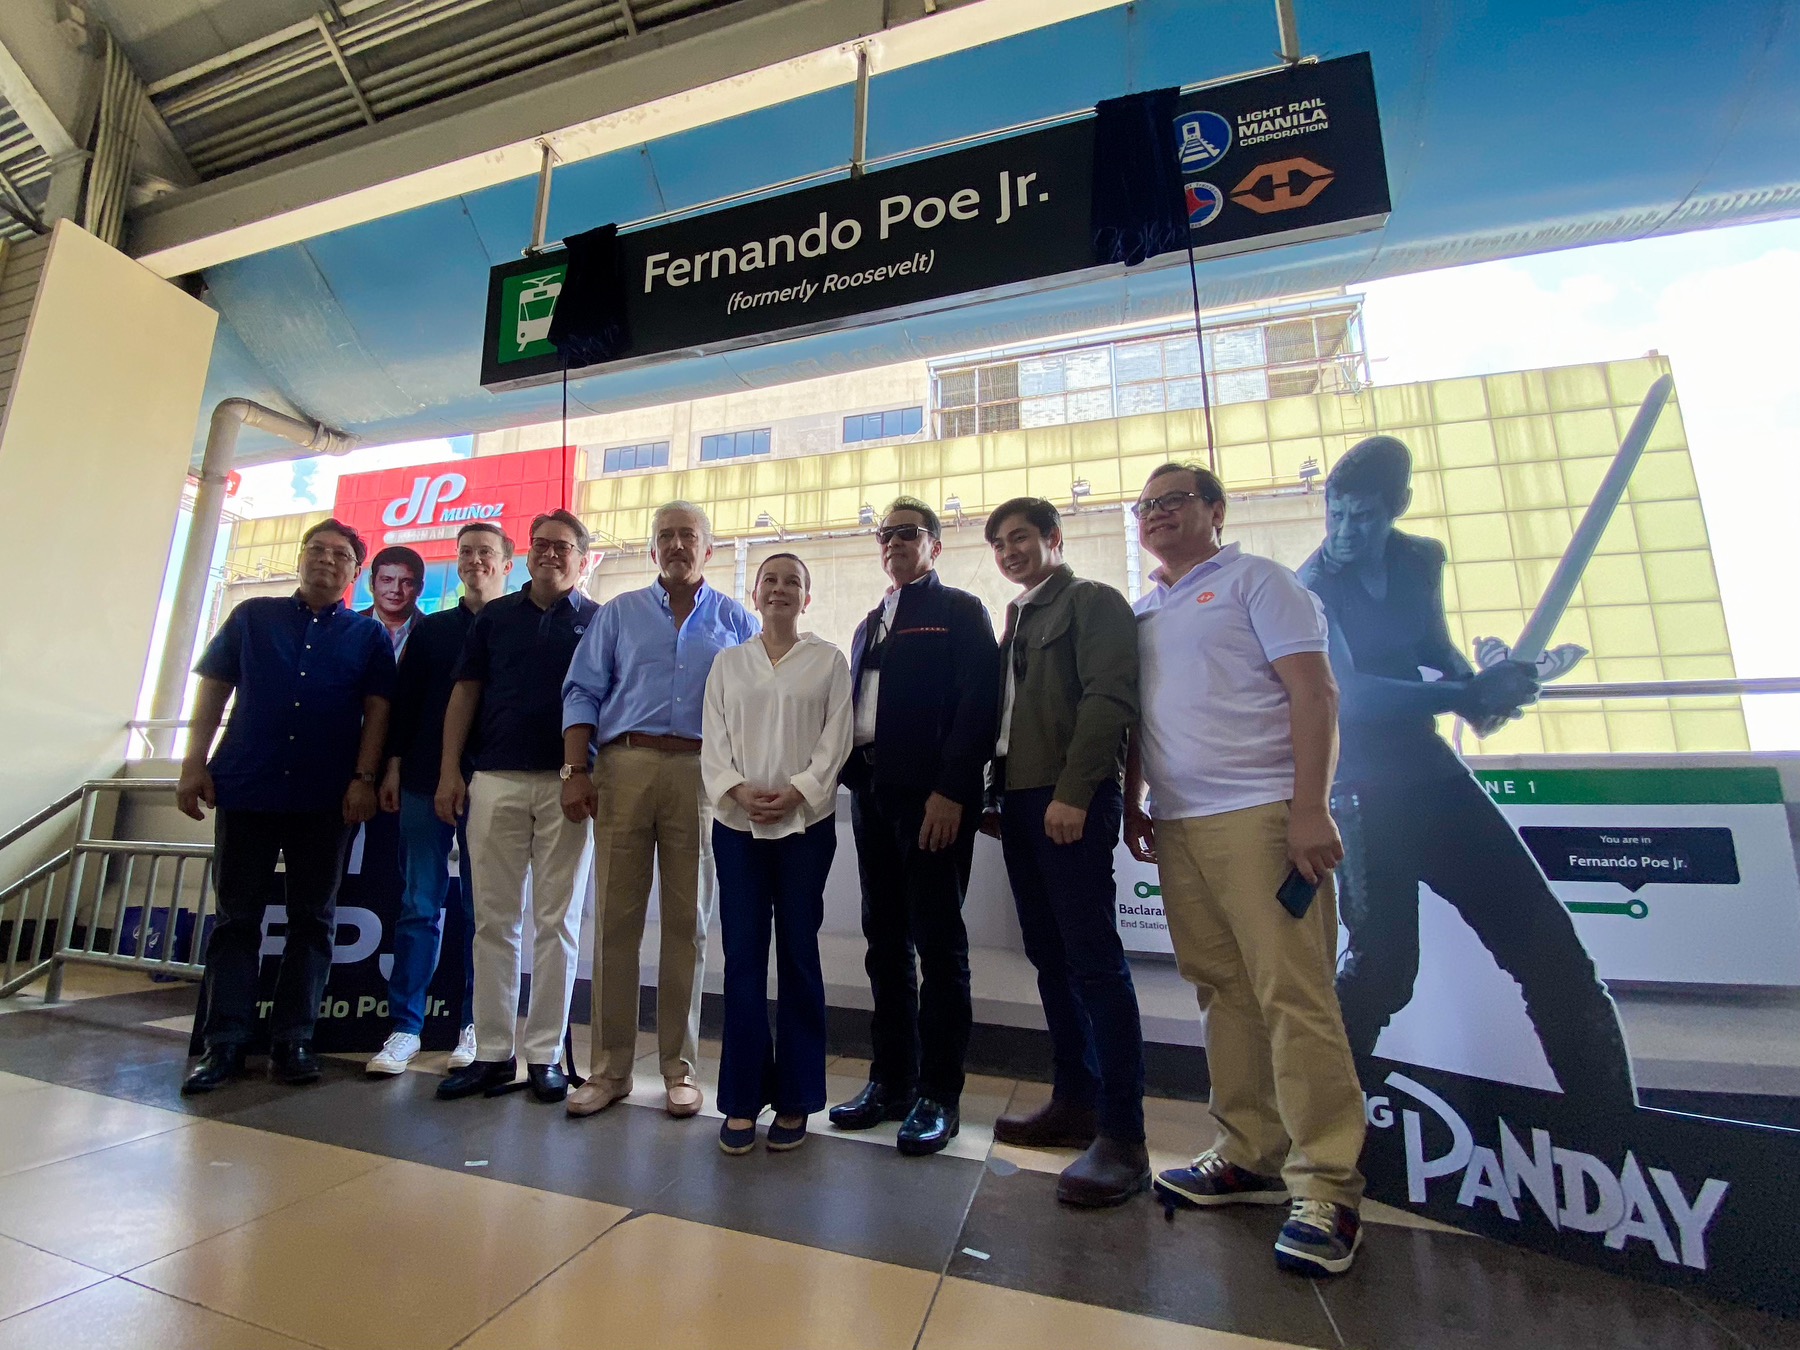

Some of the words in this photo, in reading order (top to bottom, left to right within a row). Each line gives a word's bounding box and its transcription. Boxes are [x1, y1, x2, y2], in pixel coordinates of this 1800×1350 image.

[1237, 106, 1283, 124] LIGHT
[1288, 98, 1326, 113] RAIL
[1238, 109, 1328, 138] MANILA
[1239, 121, 1329, 147] CORPORATION
[644, 211, 863, 293] Fernando
[879, 188, 980, 240] Poe
[995, 170, 1050, 225] Jr.
[726, 278, 819, 315] (formerly
[822, 249, 936, 294] Roosevelt)
[439, 502, 505, 522] MUÑOZ
[1484, 780, 1517, 794] NE
[1528, 780, 1536, 794] 1
[1599, 835, 1620, 844] You
[1641, 835, 1652, 844] in
[1569, 854, 1638, 868] Fernando
[1641, 857, 1670, 869] Poe
[1672, 857, 1689, 870] Jr.
[1120, 919, 1137, 929] End
[356, 995, 390, 1019] Po
[1384, 1071, 1731, 1270] PANDAY
